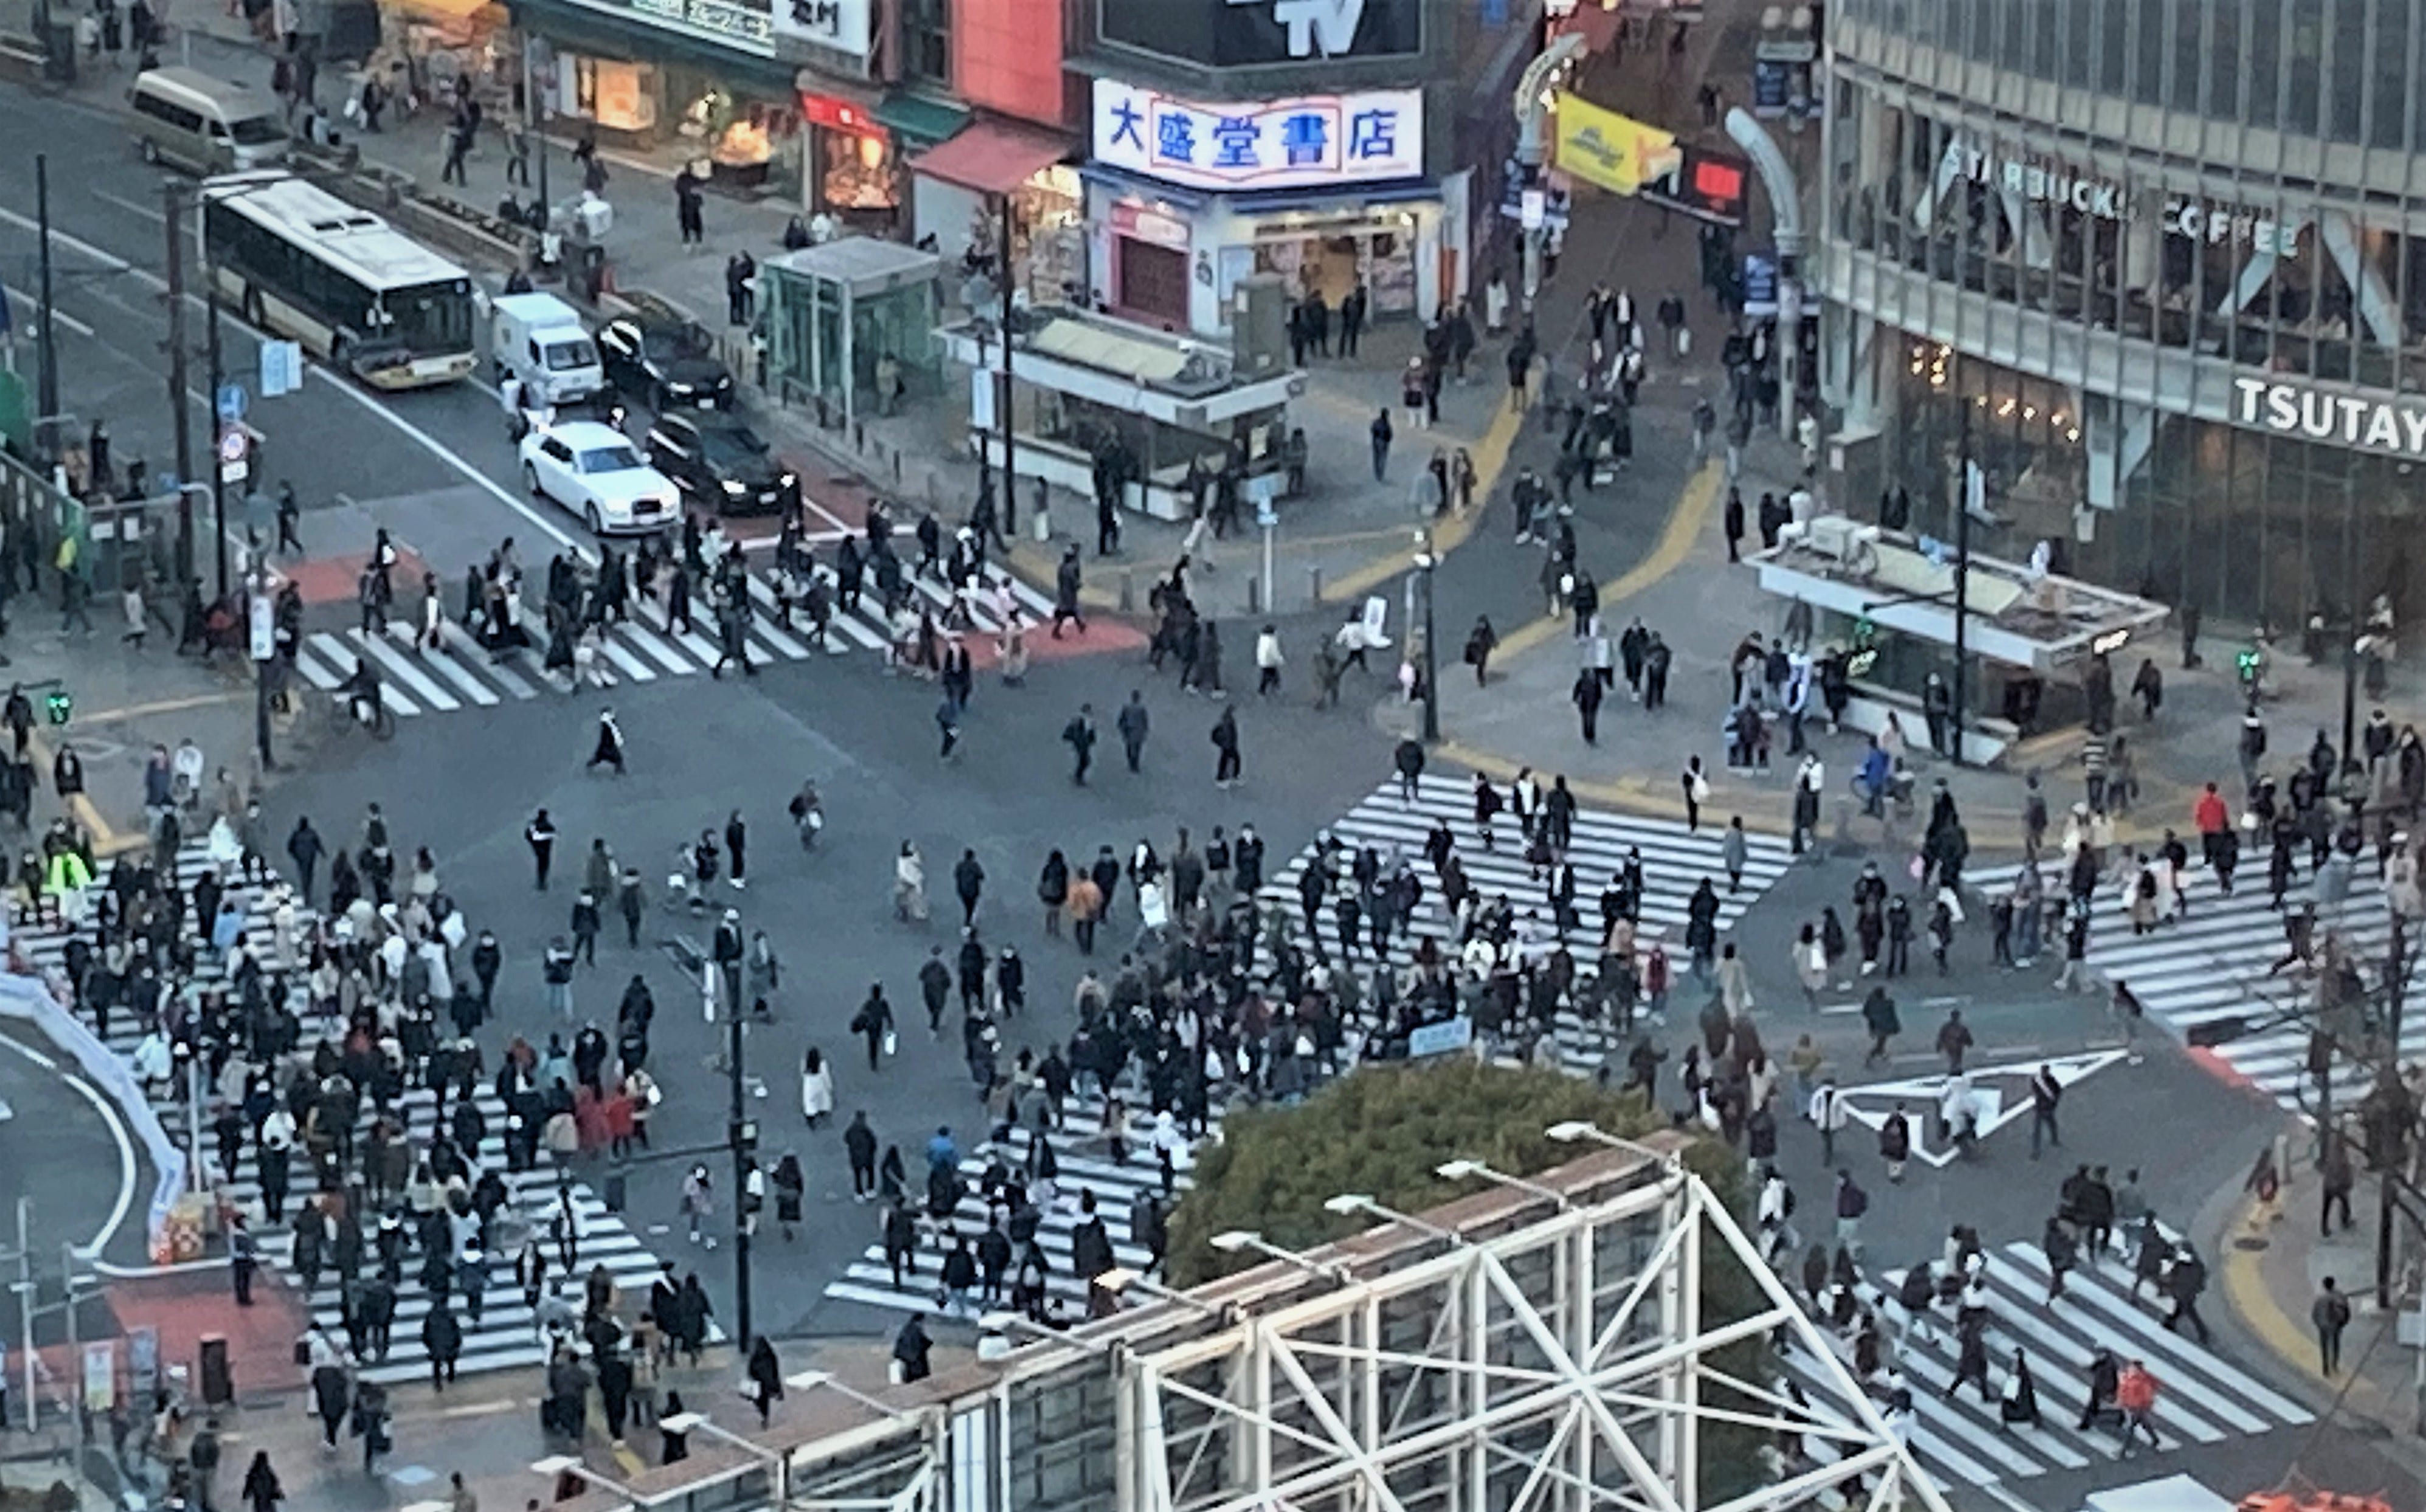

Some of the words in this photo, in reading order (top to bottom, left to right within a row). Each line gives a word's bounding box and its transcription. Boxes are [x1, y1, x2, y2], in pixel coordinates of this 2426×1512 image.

[1110, 97, 1398, 167] 大盛堂書店
[2234, 377, 2426, 454] TSUTAY
